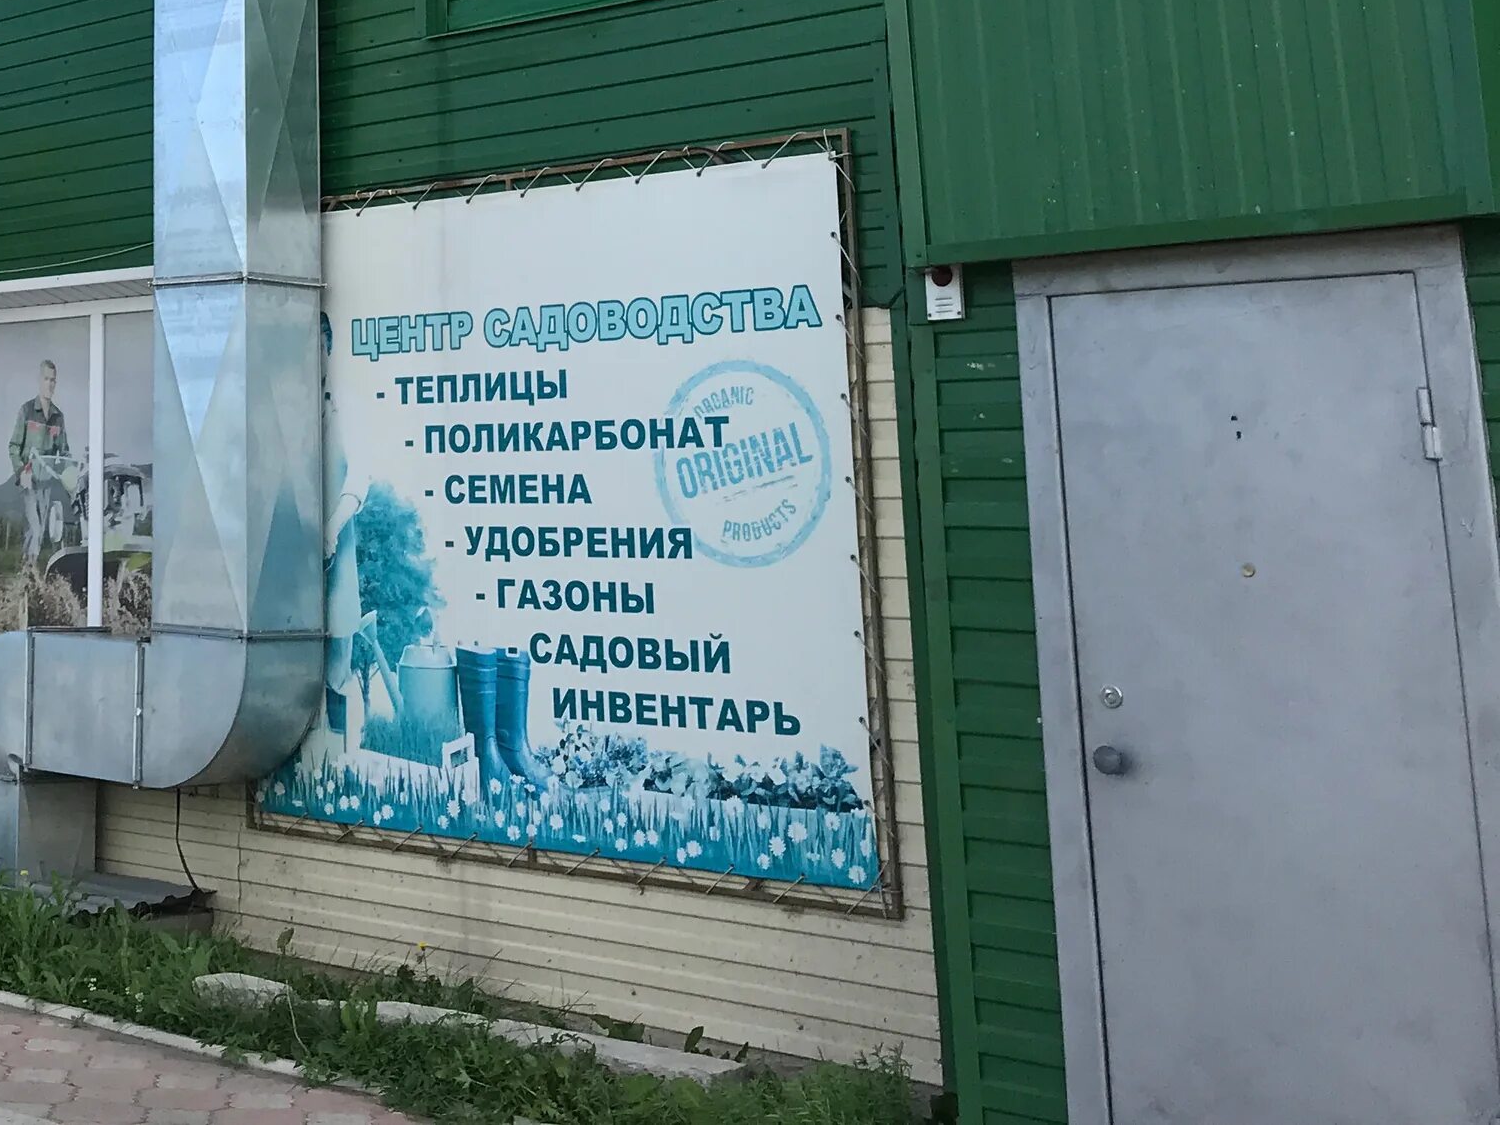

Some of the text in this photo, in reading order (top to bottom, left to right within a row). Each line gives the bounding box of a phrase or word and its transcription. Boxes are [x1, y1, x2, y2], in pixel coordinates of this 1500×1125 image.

[351, 284, 823, 361] ЦЕНТР САДОВОДСТВА
[394, 369, 568, 407] ТЕПЛИЦЫ
[693, 386, 755, 419] ORGANIC
[424, 416, 730, 454] ПОЛИКАРБОНАТ
[676, 422, 814, 500] ORIGINAL
[444, 473, 592, 506] СЕМЕНА
[722, 498, 797, 543] PRODUCTS
[465, 525, 694, 561] УДОБРЕНИЯ
[496, 578, 655, 616] ГАЗОНЫ
[528, 631, 731, 675] САДОВЫЙ
[552, 687, 802, 738] ИНВЕНТАРЬ
